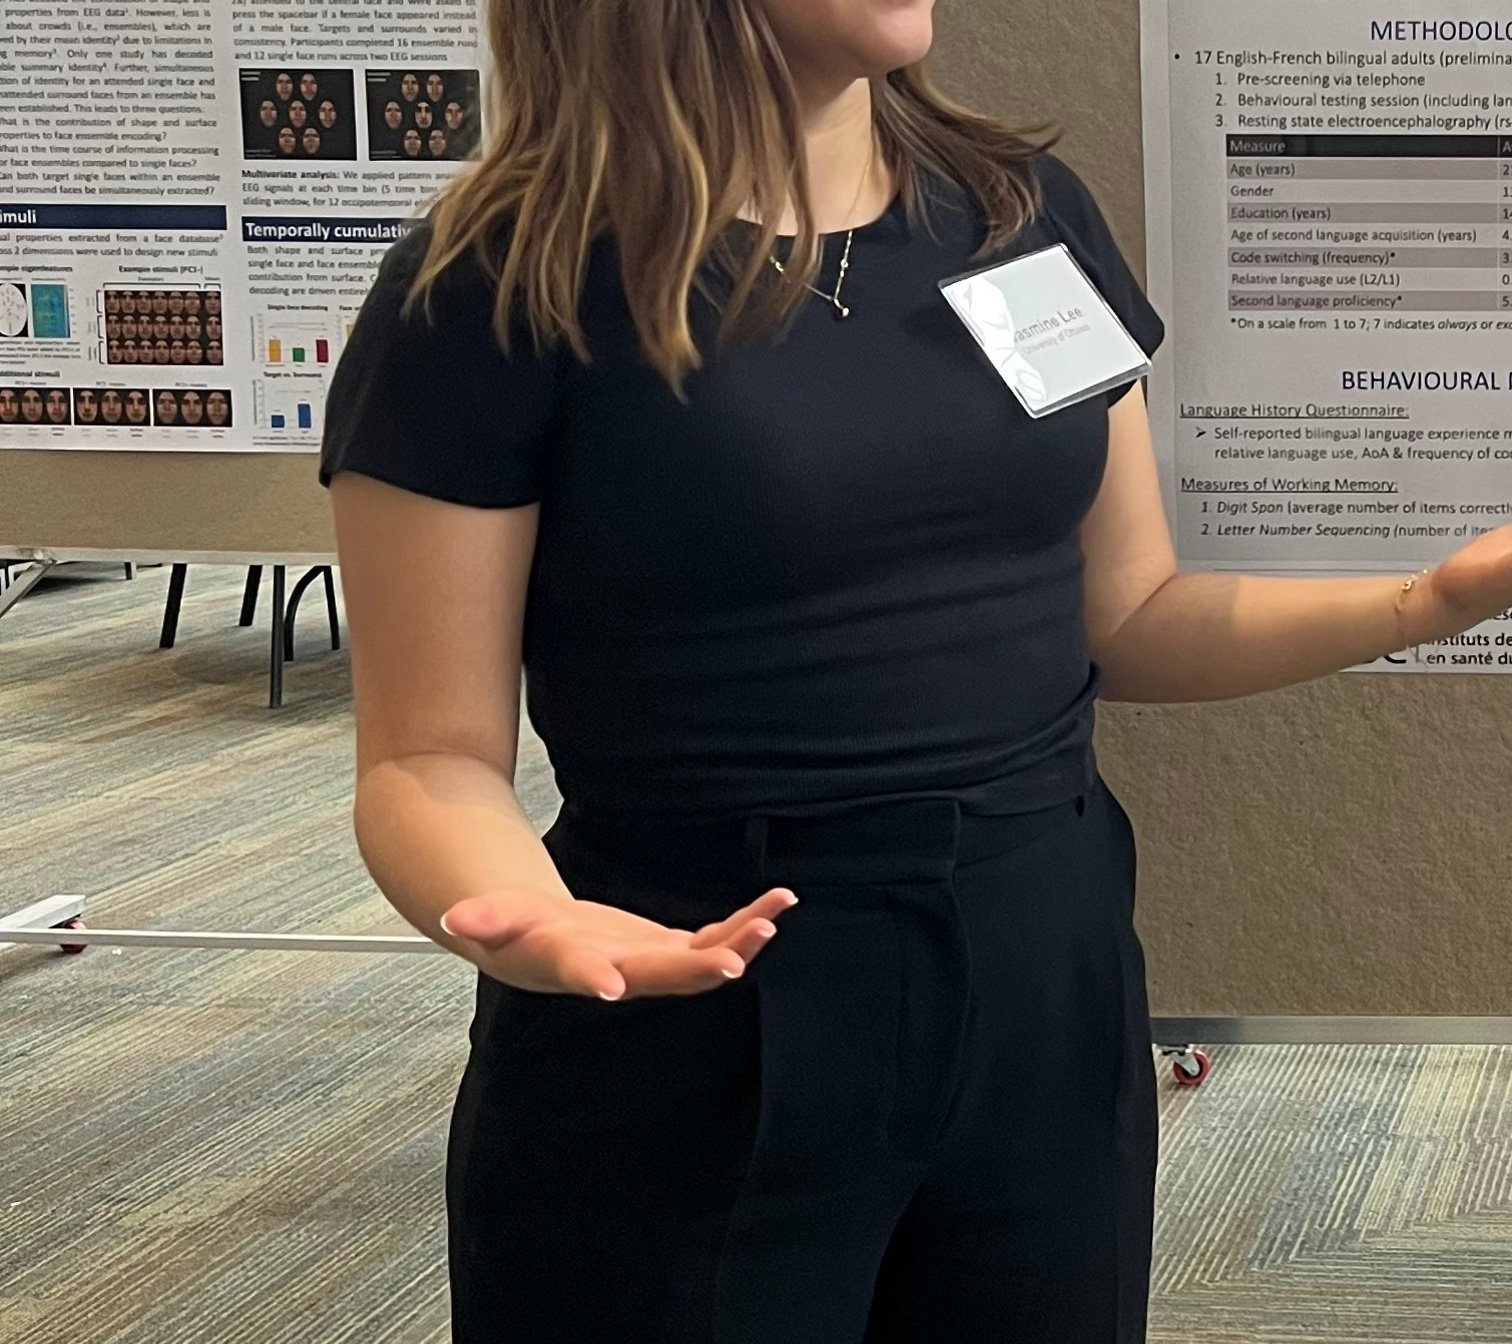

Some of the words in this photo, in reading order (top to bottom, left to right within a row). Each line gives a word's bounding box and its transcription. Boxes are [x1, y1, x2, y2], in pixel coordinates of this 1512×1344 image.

[1230, 138, 1285, 153] Measure
[245, 223, 330, 240] Temporally
[1057, 308, 1083, 323] Lee
[1342, 371, 1501, 390] BEHAVIOURAL
[1426, 633, 1490, 647] stituts
[1427, 653, 1446, 665] en
[1451, 651, 1493, 665] santé
